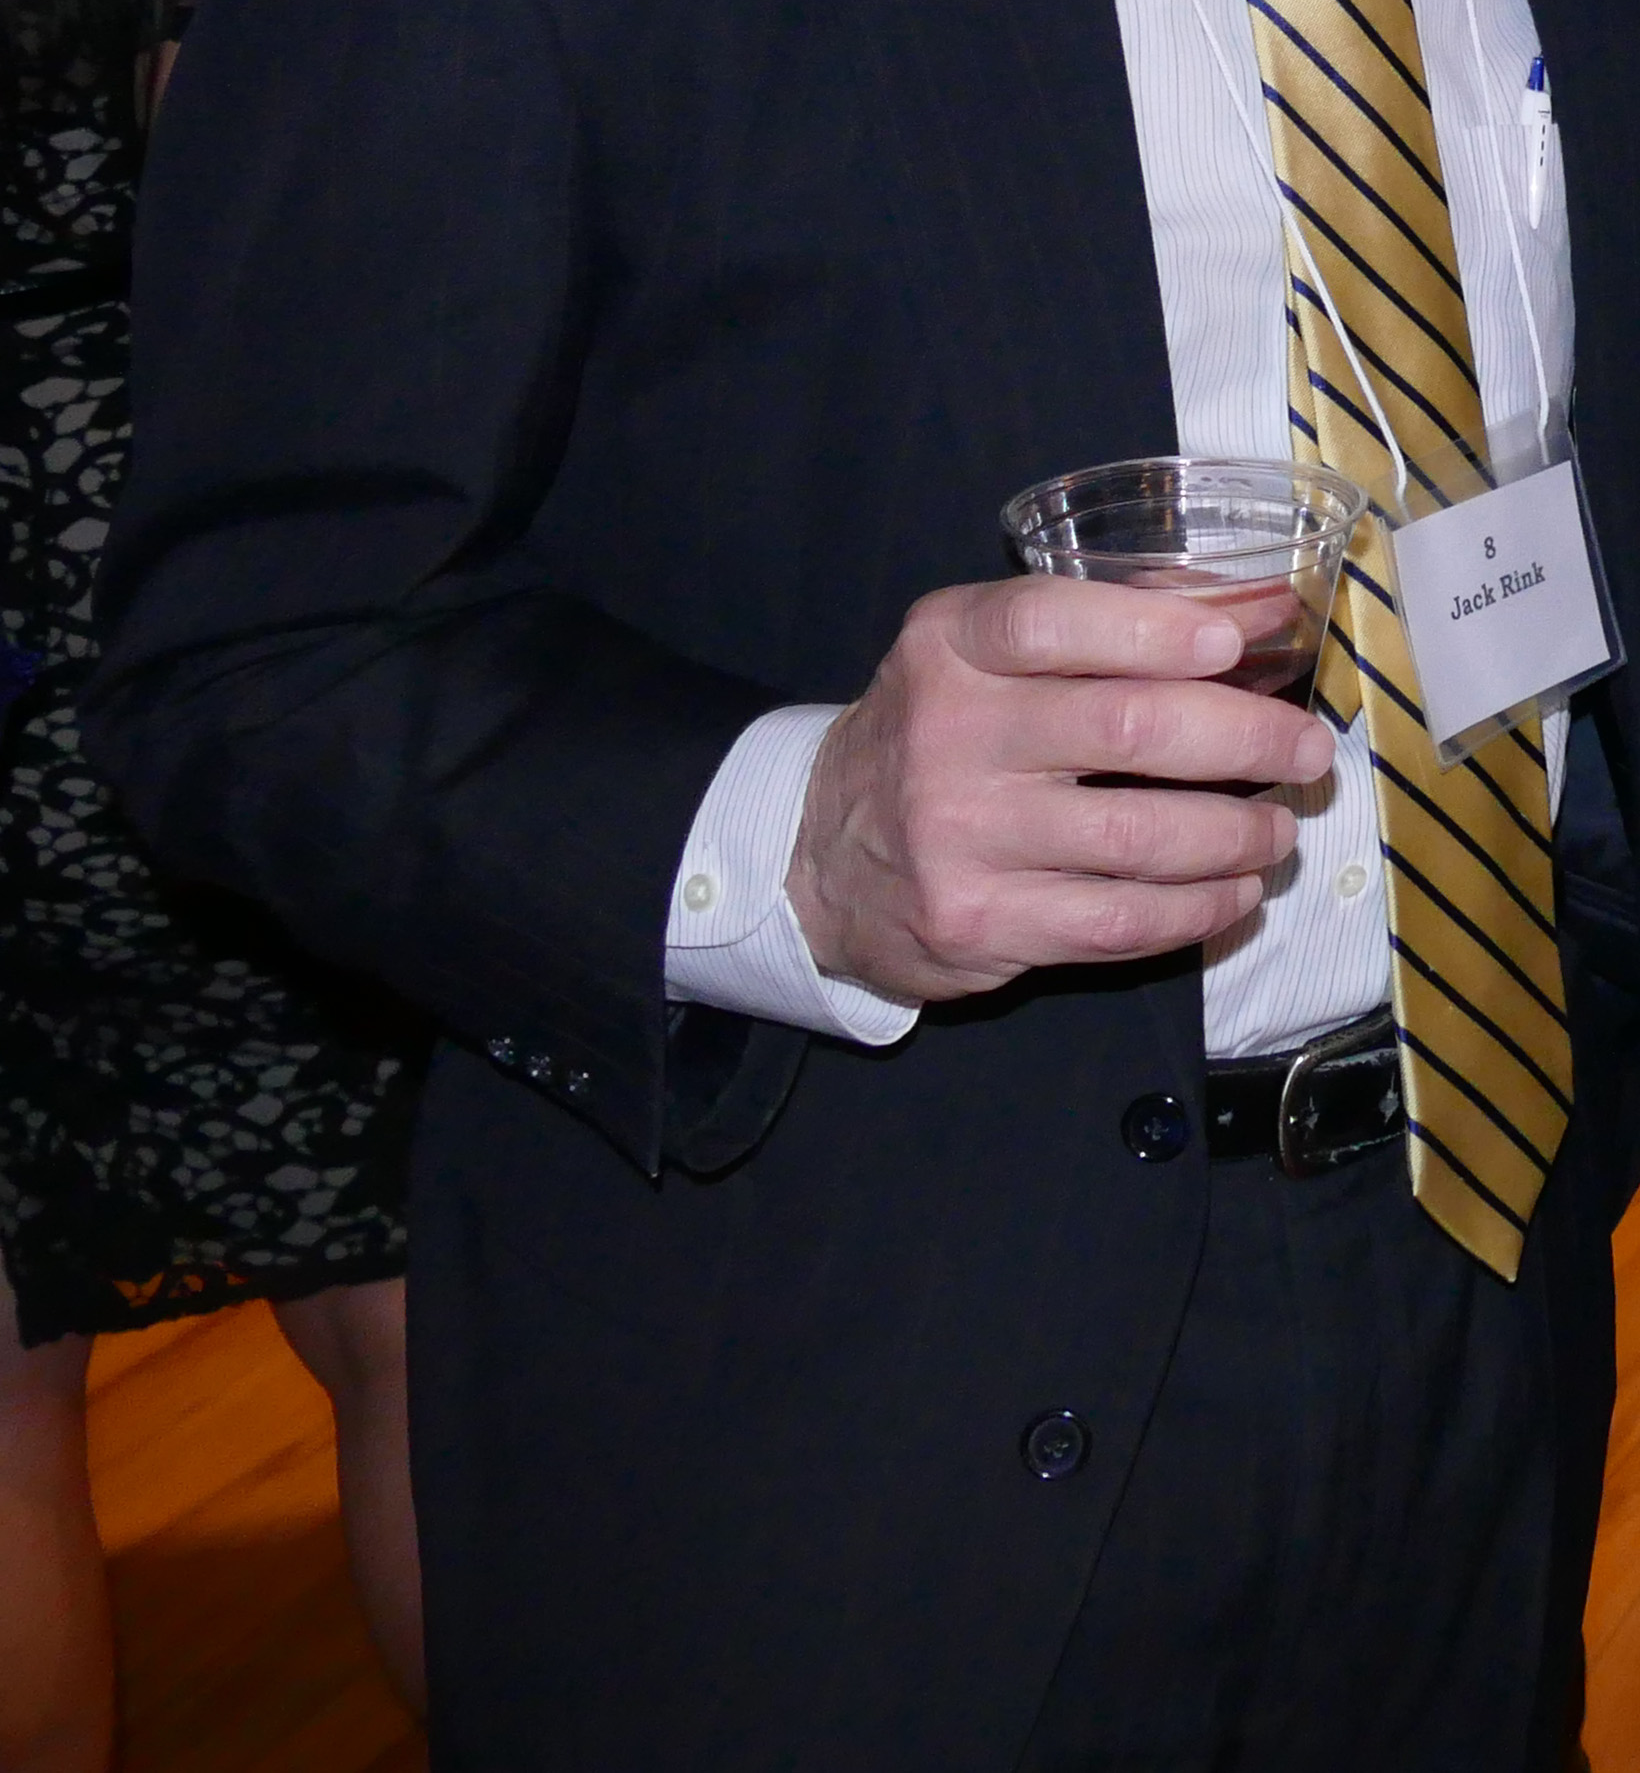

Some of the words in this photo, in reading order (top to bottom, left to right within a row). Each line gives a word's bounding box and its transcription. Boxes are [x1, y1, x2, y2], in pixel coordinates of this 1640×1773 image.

[1484, 536, 1496, 560] 8
[1451, 584, 1496, 621] Jack
[1500, 562, 1546, 600] Rink
